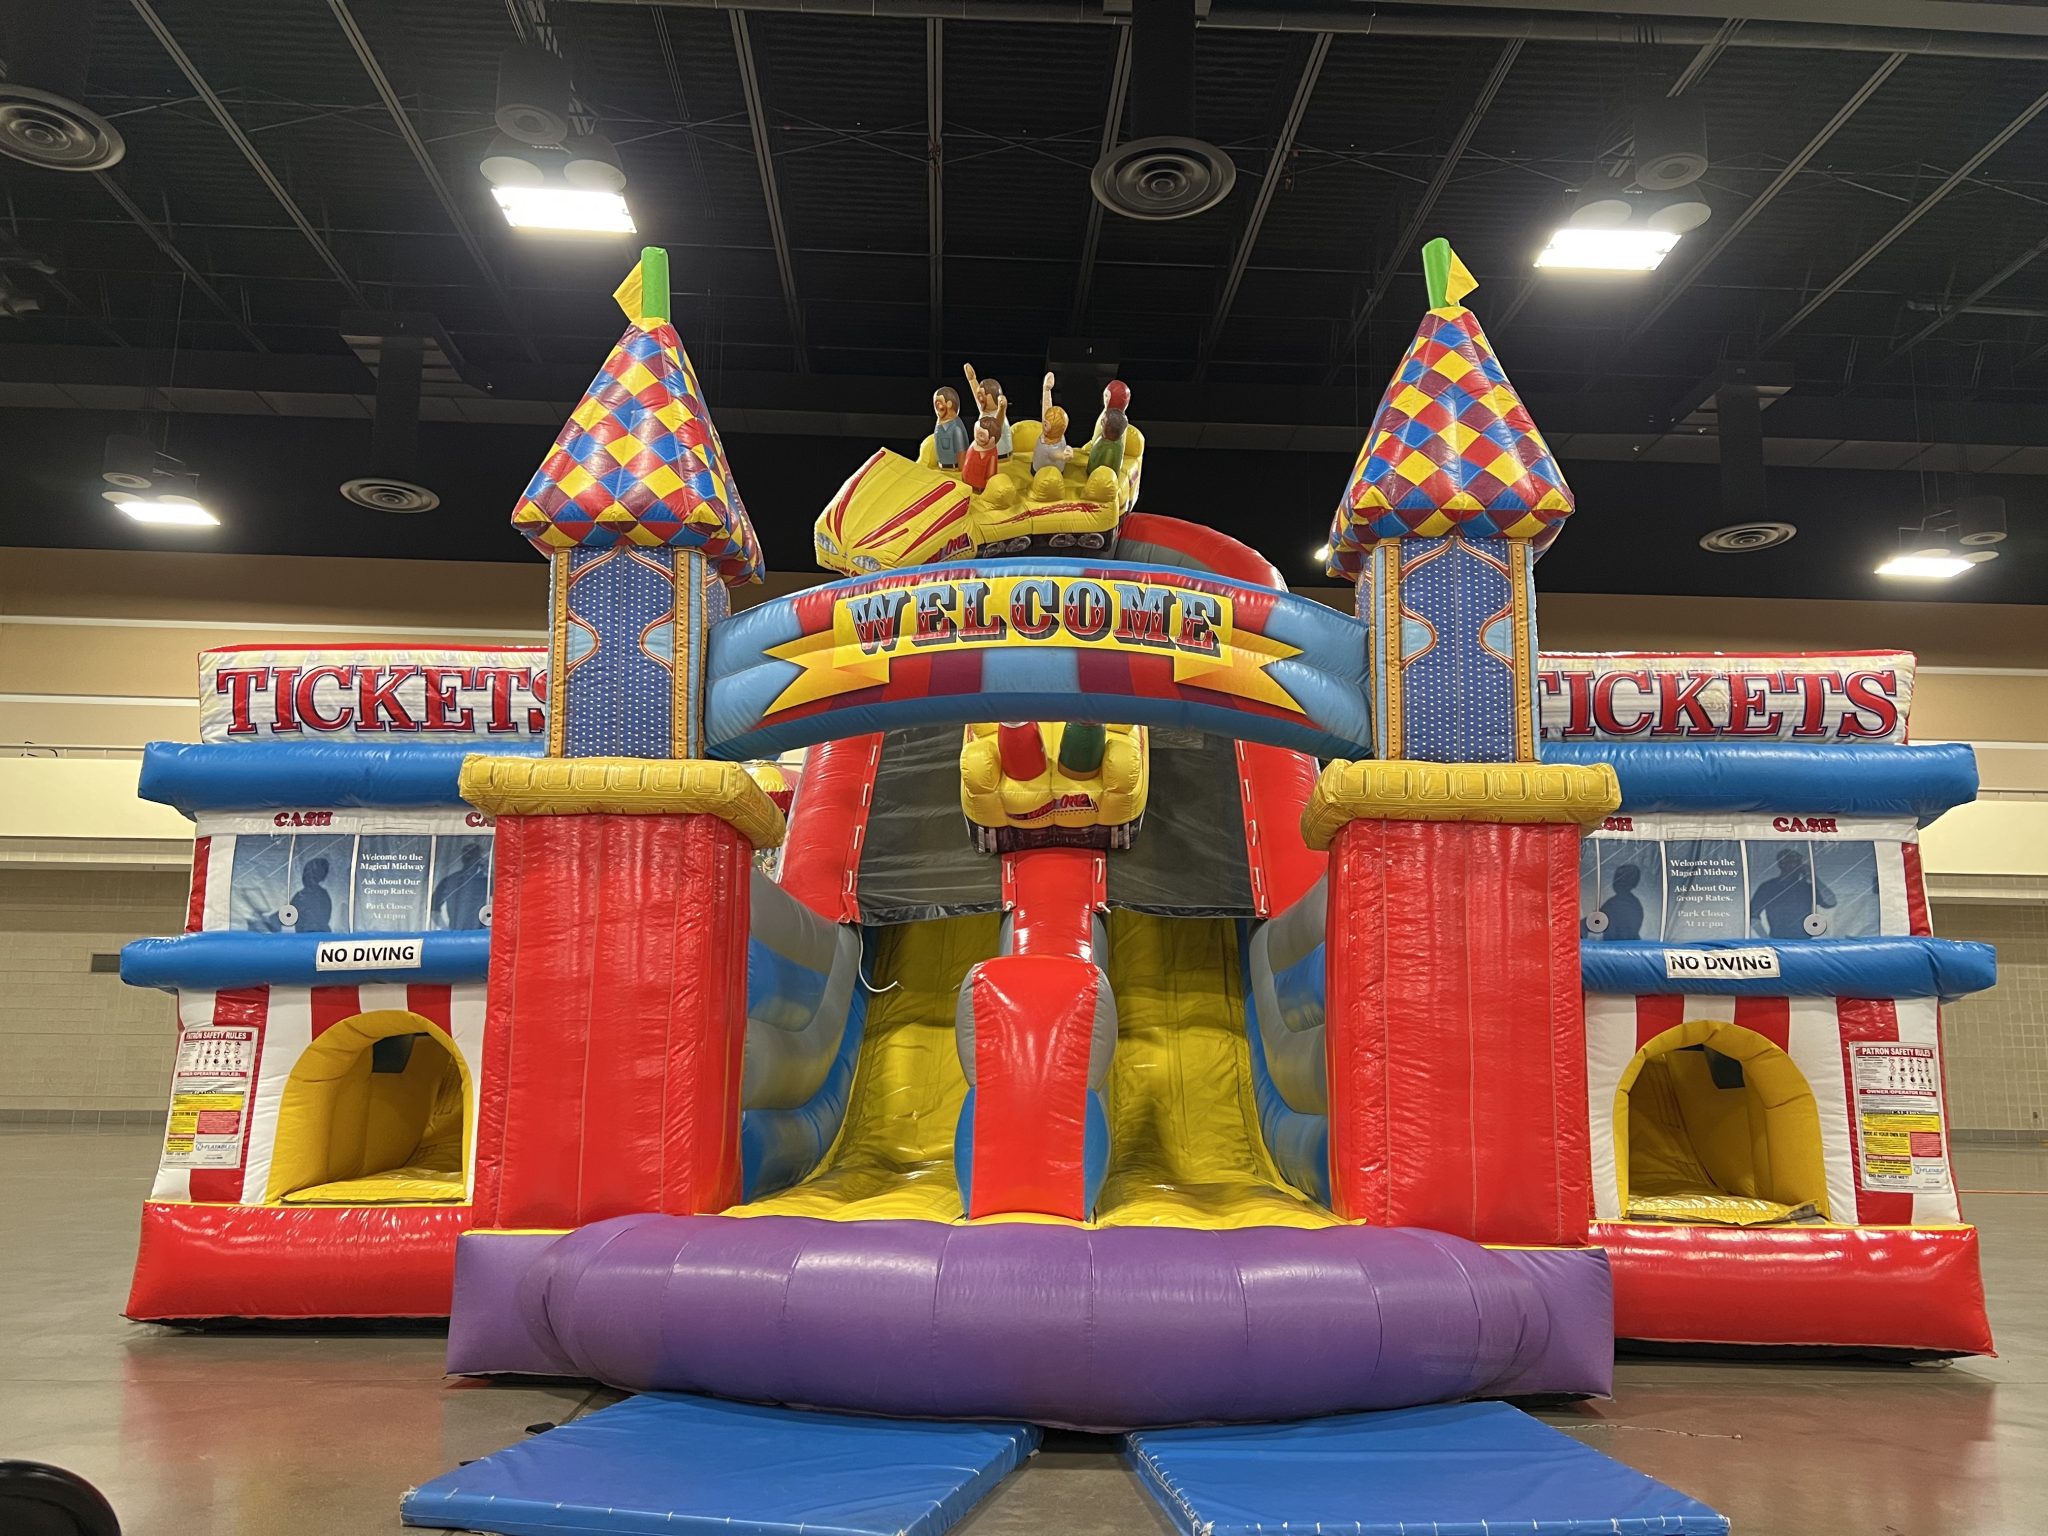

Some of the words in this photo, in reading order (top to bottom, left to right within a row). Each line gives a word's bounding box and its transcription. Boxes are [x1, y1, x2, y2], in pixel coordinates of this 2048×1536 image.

[846, 579, 1223, 658] WELCOME
[274, 811, 333, 827] CASH
[1772, 817, 1838, 833] CASH
[362, 853, 397, 861] Welcome
[409, 853, 423, 861] the
[1721, 858, 1736, 866] the
[360, 862, 390, 871] Magical
[391, 862, 425, 871] Midway
[1671, 868, 1701, 878] Magcal
[1703, 868, 1738, 877] Midway
[403, 878, 420, 886] Our
[364, 888, 389, 896] Group
[1689, 884, 1717, 892] About
[1718, 884, 1736, 892] Our
[1677, 895, 1703, 903] Group
[366, 902, 385, 910] Park
[321, 948, 347, 963] NO
[353, 946, 414, 962] DIVING
[1670, 956, 1699, 970] NO
[1704, 955, 1772, 971] DIVING
[203, 1031, 225, 1039] SAFETY
[225, 1031, 247, 1039] RULES
[1862, 1047, 1889, 1055] PATRON
[1890, 1048, 1914, 1056] SAFETY
